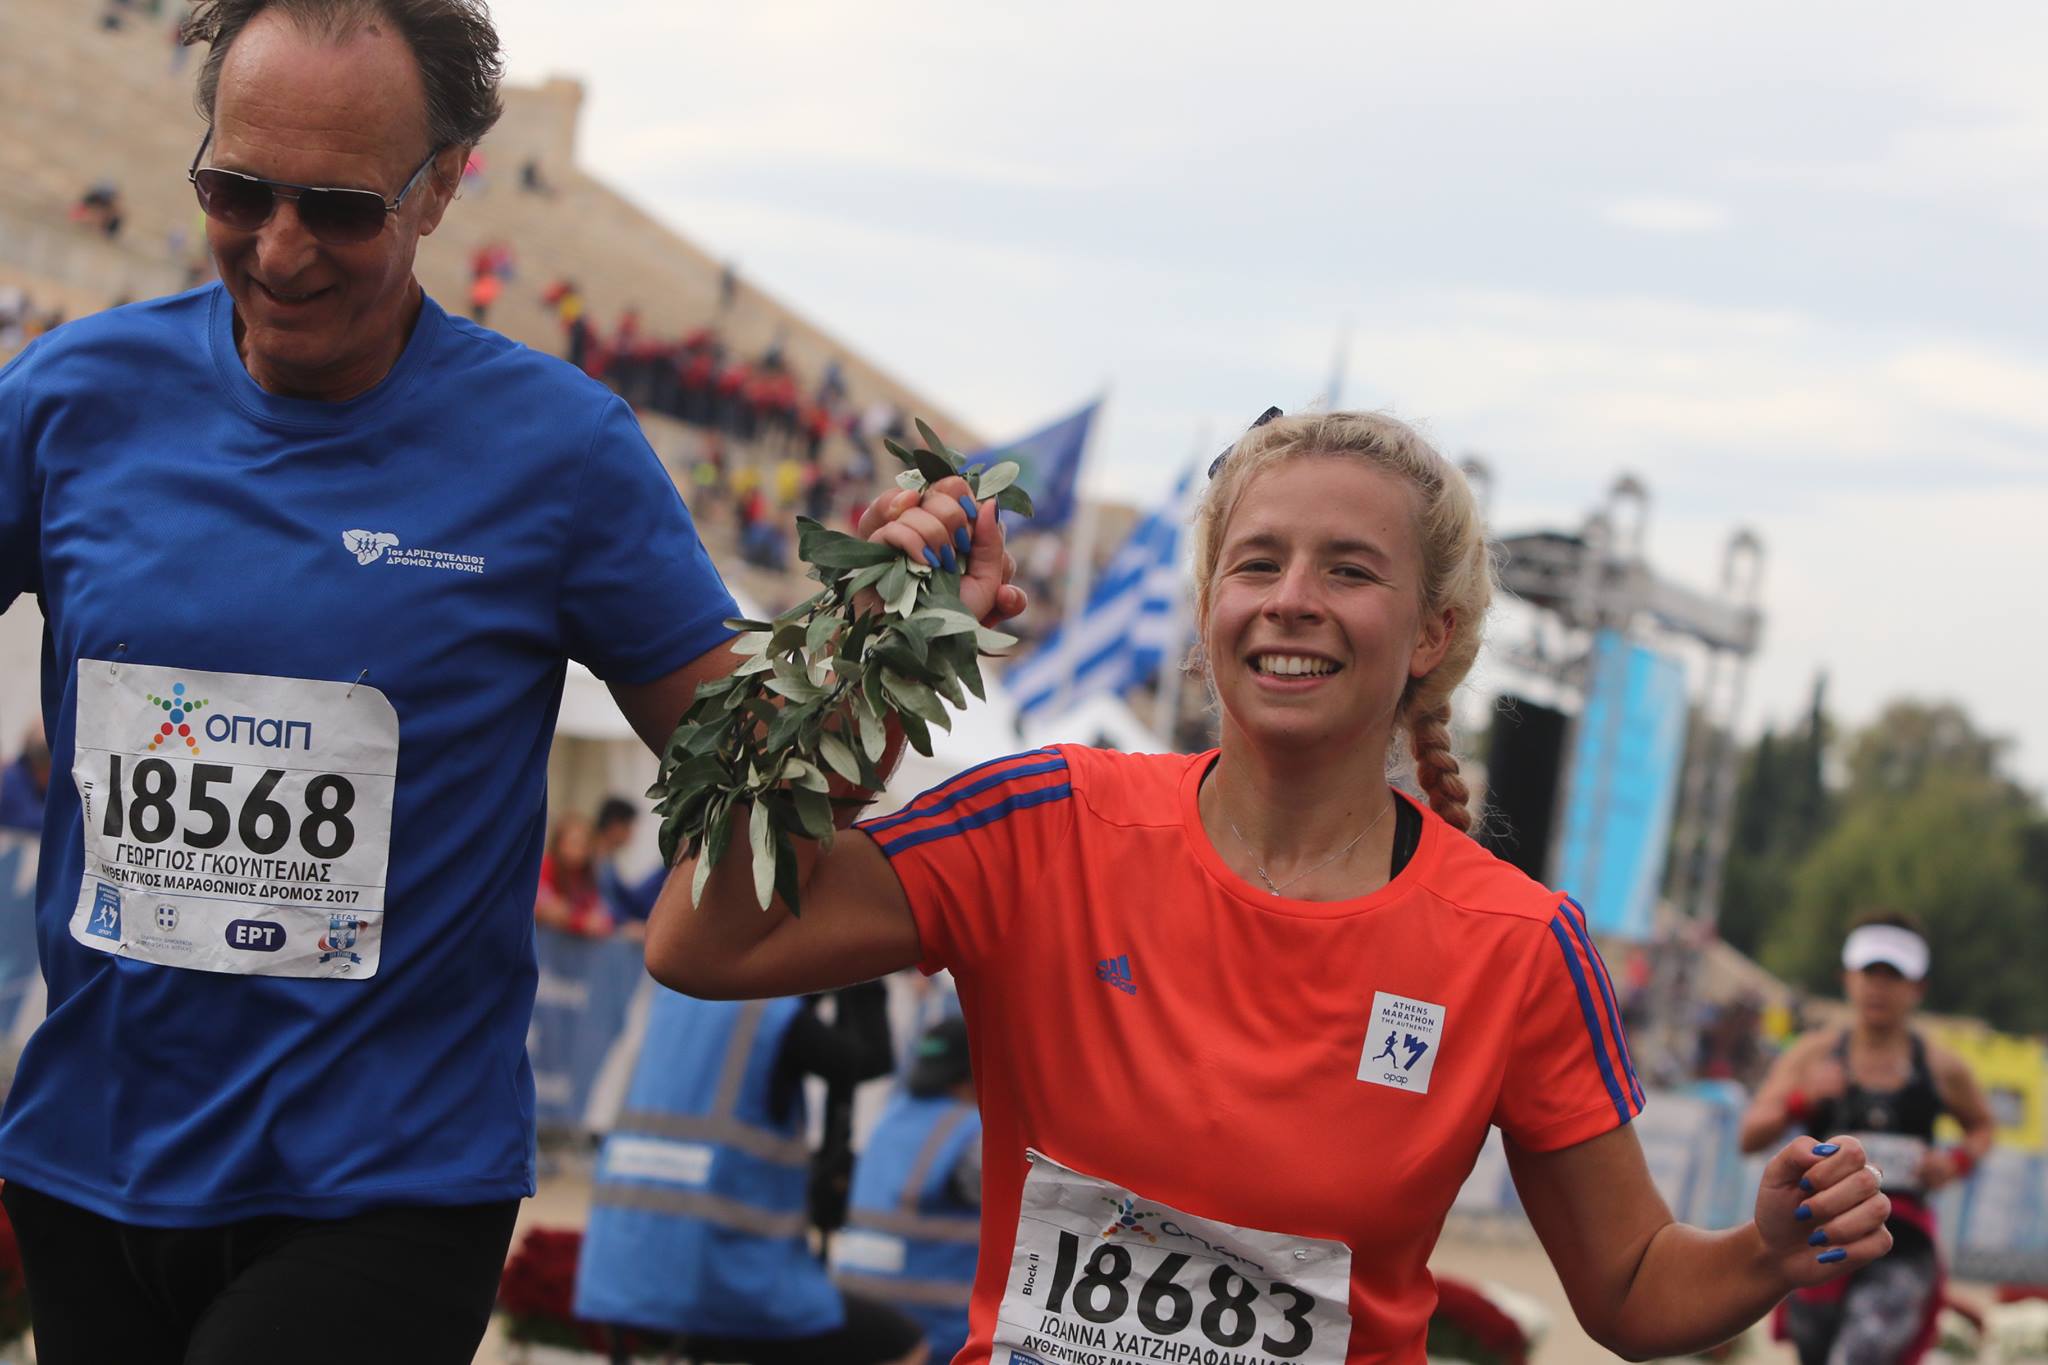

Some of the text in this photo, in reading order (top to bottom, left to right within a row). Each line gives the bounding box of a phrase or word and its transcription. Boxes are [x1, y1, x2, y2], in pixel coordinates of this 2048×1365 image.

[386, 557, 484, 574] ΔΡΟΜΟΣ ΑΝΤΟΧΗΣ
[405, 549, 485, 565] ΑΡΙΣΤΟΤΕΛΕΙΟΣ
[103, 754, 356, 859] 18568
[115, 843, 332, 883] ΓΕΩΡΓΙΟΣ ΓΚΟΥΝΤΕΛΙΑΣ
[164, 875, 257, 897] ΜΑΡΑΘΩΝΙΟΣ
[259, 883, 323, 902] ΔΡΟΜΟΣ
[326, 889, 360, 904] 2017
[1382, 1008, 1435, 1027] MARATHON
[1393, 1001, 1429, 1016] ATHENS
[1381, 1017, 1433, 1034] THE AUTHENTIC
[1383, 1072, 1409, 1086] opap
[1022, 1264, 1038, 1296] Block
[1046, 1230, 1316, 1357] 18683
[1039, 1315, 1107, 1349] ΙΩΑΝΝΑ
[1022, 1335, 1108, 1365] ΑΥΘΕΝΤΙΚΟΣ
